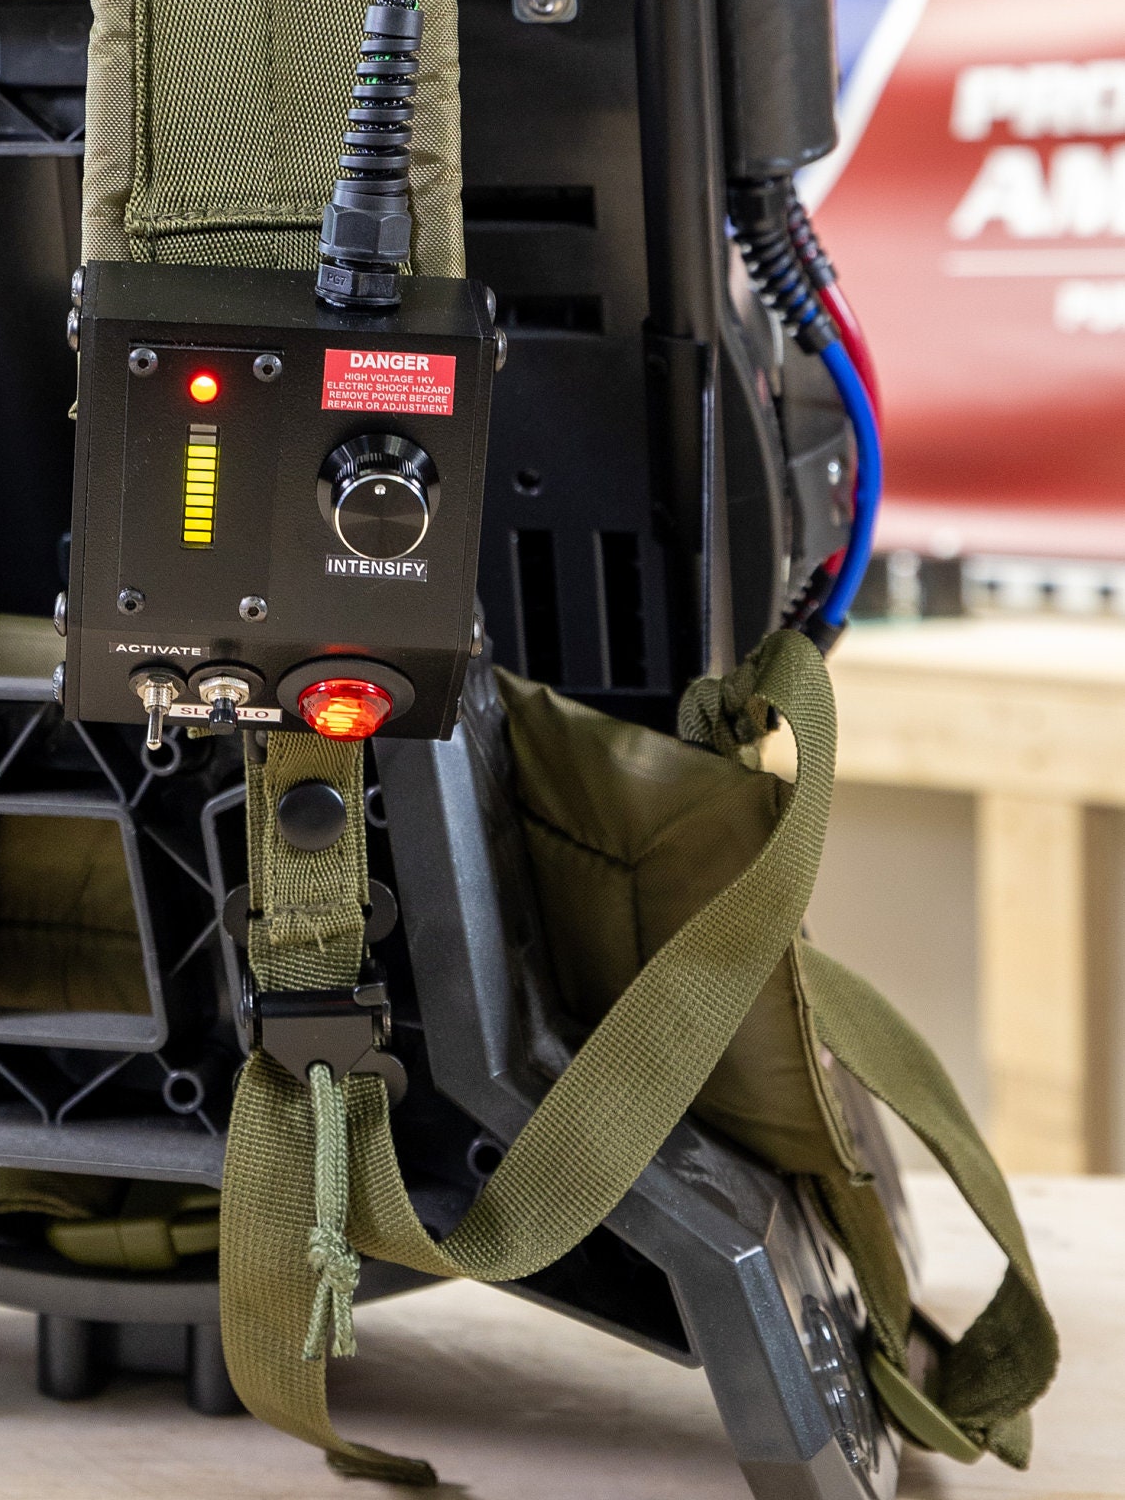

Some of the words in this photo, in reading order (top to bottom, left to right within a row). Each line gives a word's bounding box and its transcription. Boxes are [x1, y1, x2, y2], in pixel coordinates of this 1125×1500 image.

[350, 353, 430, 371] DANGER
[344, 373, 368, 381] HIGH
[370, 374, 414, 384] VOLTAGE
[416, 376, 435, 385] 1KV
[327, 381, 373, 391] ELECTRIC
[376, 384, 409, 393] SHOCK
[412, 385, 451, 395] HAZARD
[329, 390, 369, 400] REMOVE
[372, 393, 407, 402] POWER
[409, 394, 448, 404] BEFORE
[327, 400, 363, 409] REPAIR
[366, 401, 380, 410] OR
[382, 402, 449, 413] ADJUSTMENT
[328, 559, 425, 577] INTENSIFY
[115, 643, 202, 656] ACTIVATE
